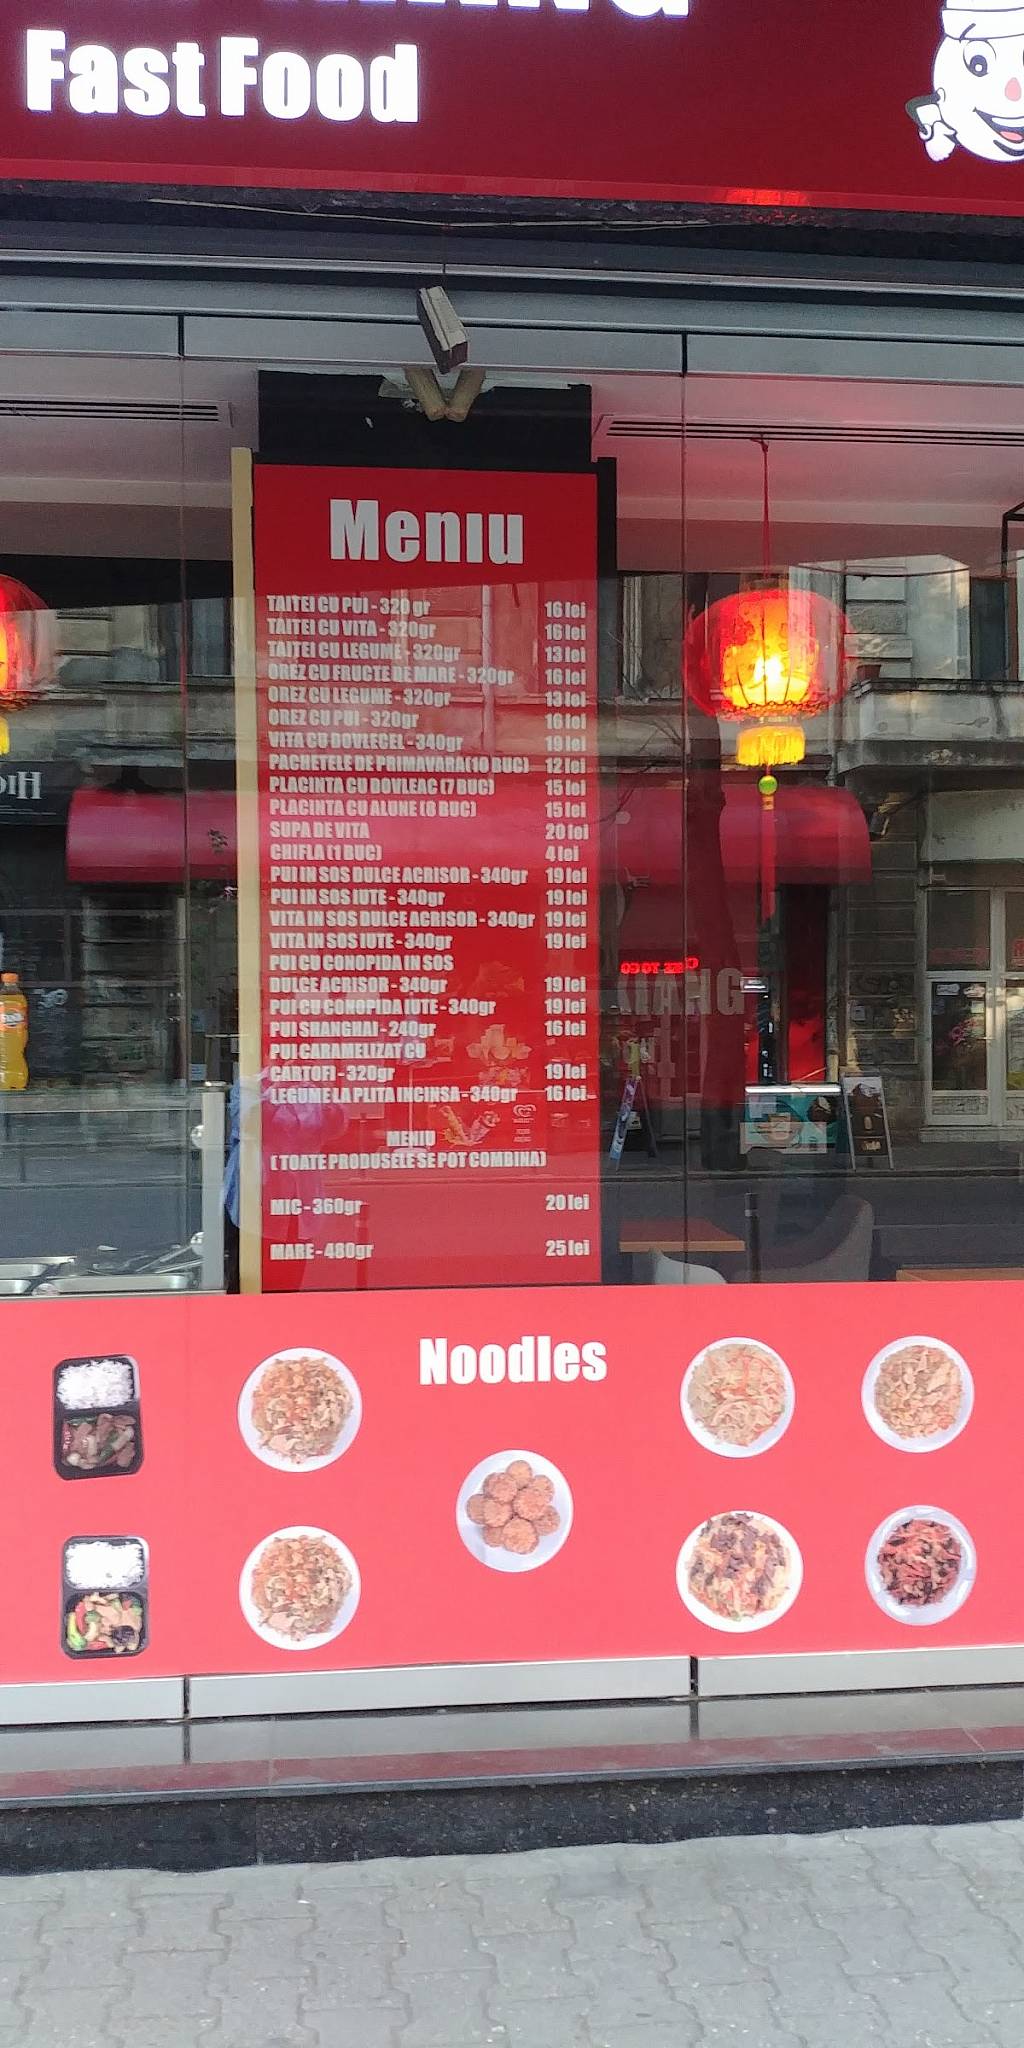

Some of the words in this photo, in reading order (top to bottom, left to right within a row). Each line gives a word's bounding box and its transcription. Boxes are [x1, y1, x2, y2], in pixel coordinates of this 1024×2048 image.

[26, 28, 206, 117] Fast
[219, 36, 419, 123] Food
[266, 595, 315, 612] TAITEI
[318, 596, 340, 613] CU
[342, 597, 368, 614] PUI
[380, 597, 410, 615] 320
[545, 601, 563, 618] 16
[565, 601, 586, 618] lei
[267, 618, 316, 635] TAITEI
[318, 619, 340, 636] CU
[341, 620, 377, 636] VITA
[388, 620, 436, 639] 320gr
[545, 623, 563, 641] 16
[565, 623, 586, 641] lei
[267, 641, 316, 658] TAITEI
[319, 642, 340, 658] CU
[342, 642, 402, 659] LEGUME
[413, 644, 460, 662] 320gr
[545, 646, 563, 663] 13
[565, 646, 586, 663] lei
[268, 663, 306, 680] OREZ
[308, 664, 330, 681] CU
[332, 664, 391, 682] FRUCTE
[414, 666, 456, 683] MARE
[467, 667, 514, 686] 320gr
[545, 668, 563, 685] 16
[565, 668, 586, 685] lei
[268, 685, 307, 702] OREZ
[309, 686, 330, 704] CU
[332, 687, 393, 704] LEGUME
[403, 688, 451, 707] 320gr
[545, 691, 563, 708] 13
[565, 691, 586, 708] lei
[268, 708, 307, 725] OREZ
[309, 709, 331, 726] CU
[332, 710, 360, 726] PUI
[370, 711, 419, 729] 320gr
[545, 713, 563, 730] 16
[565, 713, 586, 730] lei
[268, 731, 305, 748] VITA
[306, 732, 329, 749] CU
[330, 732, 405, 750] DOVLECEL
[415, 733, 463, 752] 340gr
[545, 735, 563, 752] 19
[565, 735, 586, 752] lei
[269, 754, 353, 771] PACHETELE
[354, 755, 374, 771] DE
[491, 756, 529, 773] BUC)
[545, 757, 563, 774] 12
[564, 757, 586, 774] lei
[269, 776, 344, 793] PLACINTA
[346, 777, 369, 794] CU
[370, 777, 438, 795] DOVLEAC
[456, 778, 495, 795] BUC)
[545, 779, 563, 796] 15
[564, 779, 586, 796] lei
[269, 798, 345, 815] PLACINTA
[346, 799, 369, 816] CU
[370, 799, 417, 817] ALUNE
[438, 800, 477, 817] BUC)
[545, 801, 563, 818] 15
[564, 801, 586, 818] lei
[270, 821, 311, 837] SUPA
[312, 821, 333, 838] DE
[334, 822, 369, 839] VITA
[545, 823, 566, 840] 20
[567, 823, 589, 840] lei
[270, 843, 325, 860] CHIFLA
[342, 844, 383, 861] BUC)
[545, 845, 556, 862] 4
[557, 845, 580, 862] lei
[270, 866, 298, 883] PUI
[299, 866, 317, 882] IN
[318, 866, 351, 883] SOS
[352, 866, 401, 883] DULCE
[401, 866, 470, 884] ACRISOR
[481, 866, 528, 885] 340gr
[545, 867, 564, 884] 19
[566, 867, 588, 884] lei
[270, 888, 298, 905] PUI
[300, 888, 318, 905] IN
[319, 888, 351, 905] SOS
[352, 888, 387, 905] IUTE
[397, 889, 446, 907] 340gr
[546, 889, 564, 906] 19
[566, 889, 588, 906] lei
[269, 910, 306, 927] VITA
[307, 910, 324, 927] IN
[326, 910, 358, 927] SOS
[360, 910, 408, 927] DULCE
[409, 911, 478, 928] ACRISOR
[487, 911, 536, 929] 340gr
[545, 911, 563, 928] 19
[565, 911, 587, 928] lei
[269, 932, 306, 949] VITA
[307, 932, 325, 949] IN
[326, 932, 358, 949] SOS
[359, 932, 395, 949] IUTE
[404, 932, 453, 951] 340gr
[545, 932, 563, 949] 19
[565, 932, 587, 949] lei
[270, 954, 297, 970] PUI
[298, 954, 321, 971] CU
[322, 954, 402, 971] CONOPIDA
[403, 954, 421, 971] IN
[422, 954, 454, 971] SOS
[270, 976, 320, 993] DULCE
[320, 977, 389, 993] ACRISOR
[399, 976, 448, 995] 340gr
[544, 976, 563, 993] 19
[564, 976, 586, 993] lei
[270, 999, 297, 1015] PUI
[299, 999, 321, 1015] CU
[323, 999, 403, 1015] CONOPIDA
[404, 999, 439, 1015] IUTE
[448, 998, 496, 1017] 340gr
[544, 998, 563, 1015] 19
[564, 998, 586, 1015] lei
[270, 1020, 298, 1037] PUI
[299, 1020, 378, 1037] SHANGHAI
[389, 1020, 436, 1039] 240gr
[544, 1020, 563, 1037] 16
[564, 1020, 586, 1037] lei
[270, 1043, 298, 1060] PUI
[300, 1043, 402, 1059] CARAMELIZAT
[404, 1042, 426, 1059] CU
[270, 1065, 336, 1082] CARTOFI
[346, 1065, 395, 1083] 320gr
[544, 1063, 563, 1080] 19
[564, 1063, 587, 1080] lei
[271, 1087, 331, 1104] LEGUME
[331, 1087, 352, 1103] LA
[353, 1087, 396, 1103] PLITA
[396, 1086, 460, 1103] INCINSA
[470, 1086, 518, 1103] 340gr
[544, 1085, 563, 1102] 16
[564, 1085, 587, 1102] lei
[387, 1130, 436, 1147] MENIU
[279, 1154, 327, 1170] TOATE
[328, 1153, 416, 1170] PRODUSELE
[417, 1152, 436, 1169] SE
[438, 1152, 468, 1169] POT
[270, 1198, 302, 1216] MIC
[312, 1198, 362, 1216] 360gr
[546, 1194, 567, 1211] 20
[568, 1194, 590, 1211] lei
[270, 1244, 314, 1260] MARE
[324, 1243, 374, 1260] 480gr
[546, 1239, 567, 1257] 25
[568, 1239, 590, 1257] lei
[419, 1335, 607, 1385] Noodles
